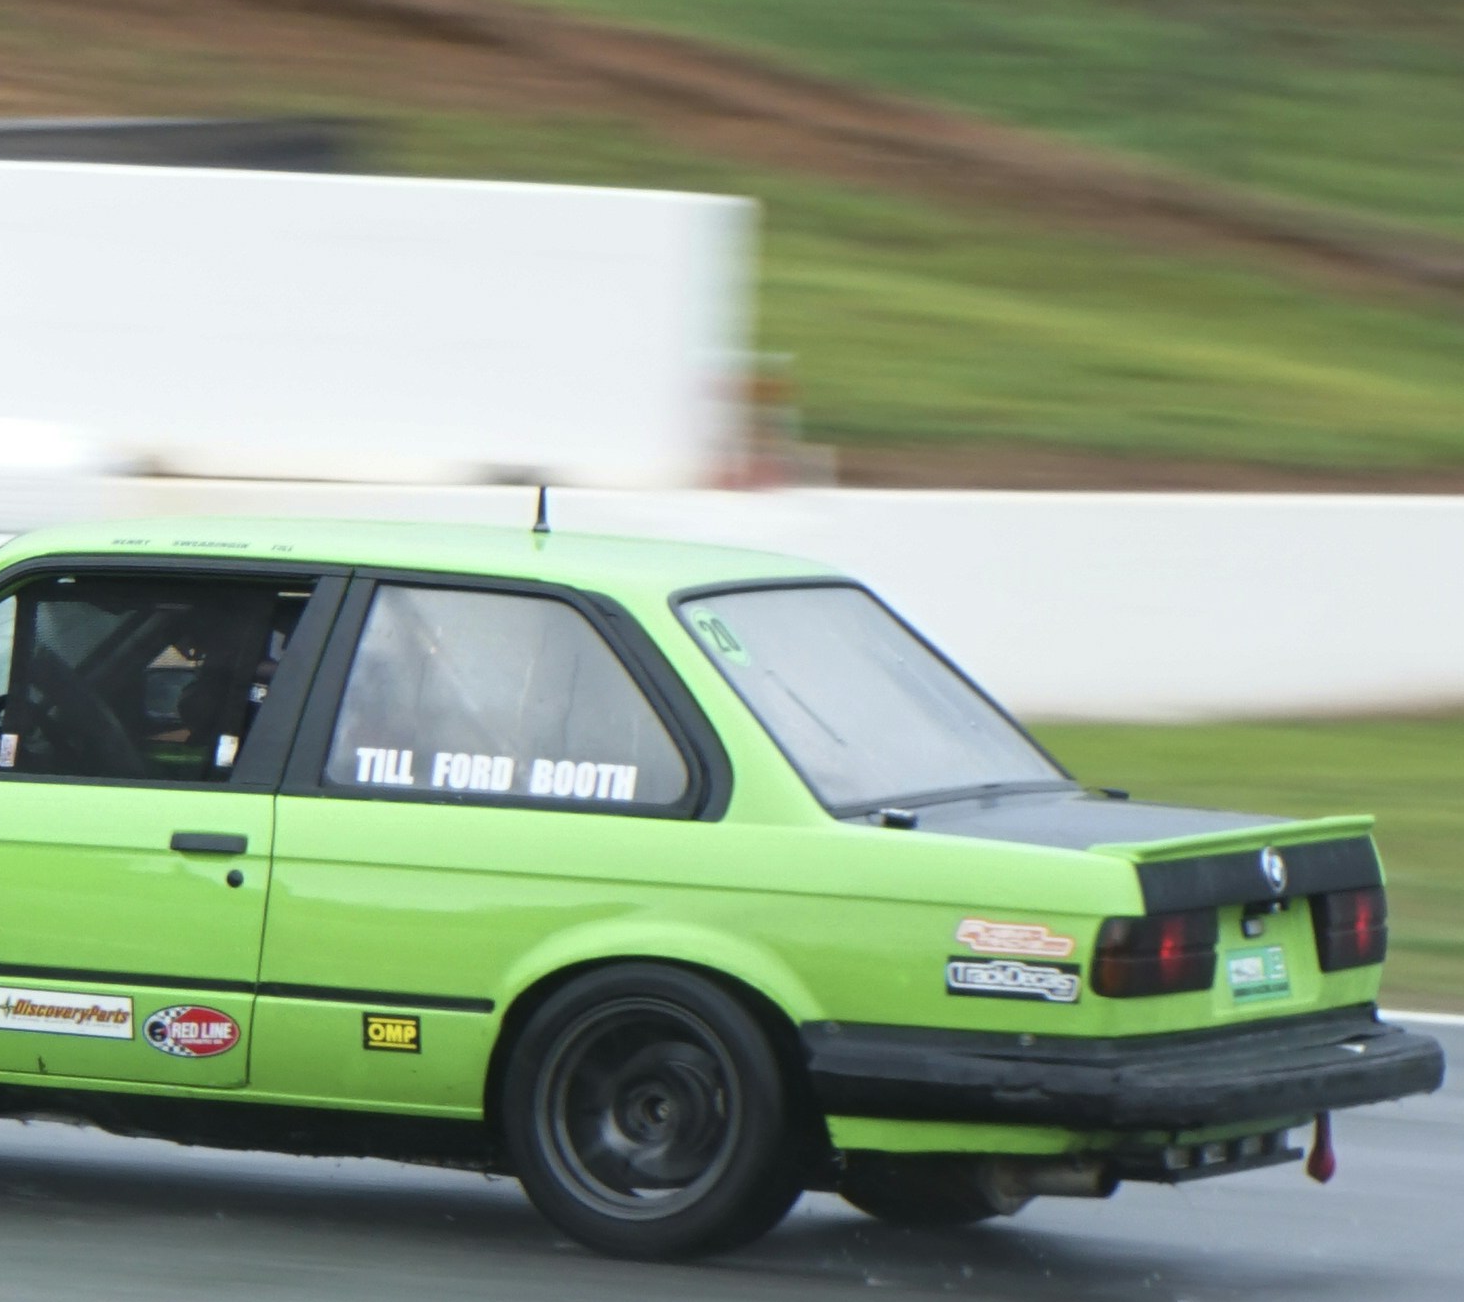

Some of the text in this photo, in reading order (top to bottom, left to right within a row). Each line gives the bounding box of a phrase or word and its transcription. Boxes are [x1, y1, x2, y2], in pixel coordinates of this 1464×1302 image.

[698, 618, 742, 652] 20
[356, 747, 638, 800] TILL FORD BOOTH
[13, 998, 130, 1025] DiscoveryParts
[172, 1021, 232, 1039] RED LINE
[368, 1023, 417, 1043] OMP
